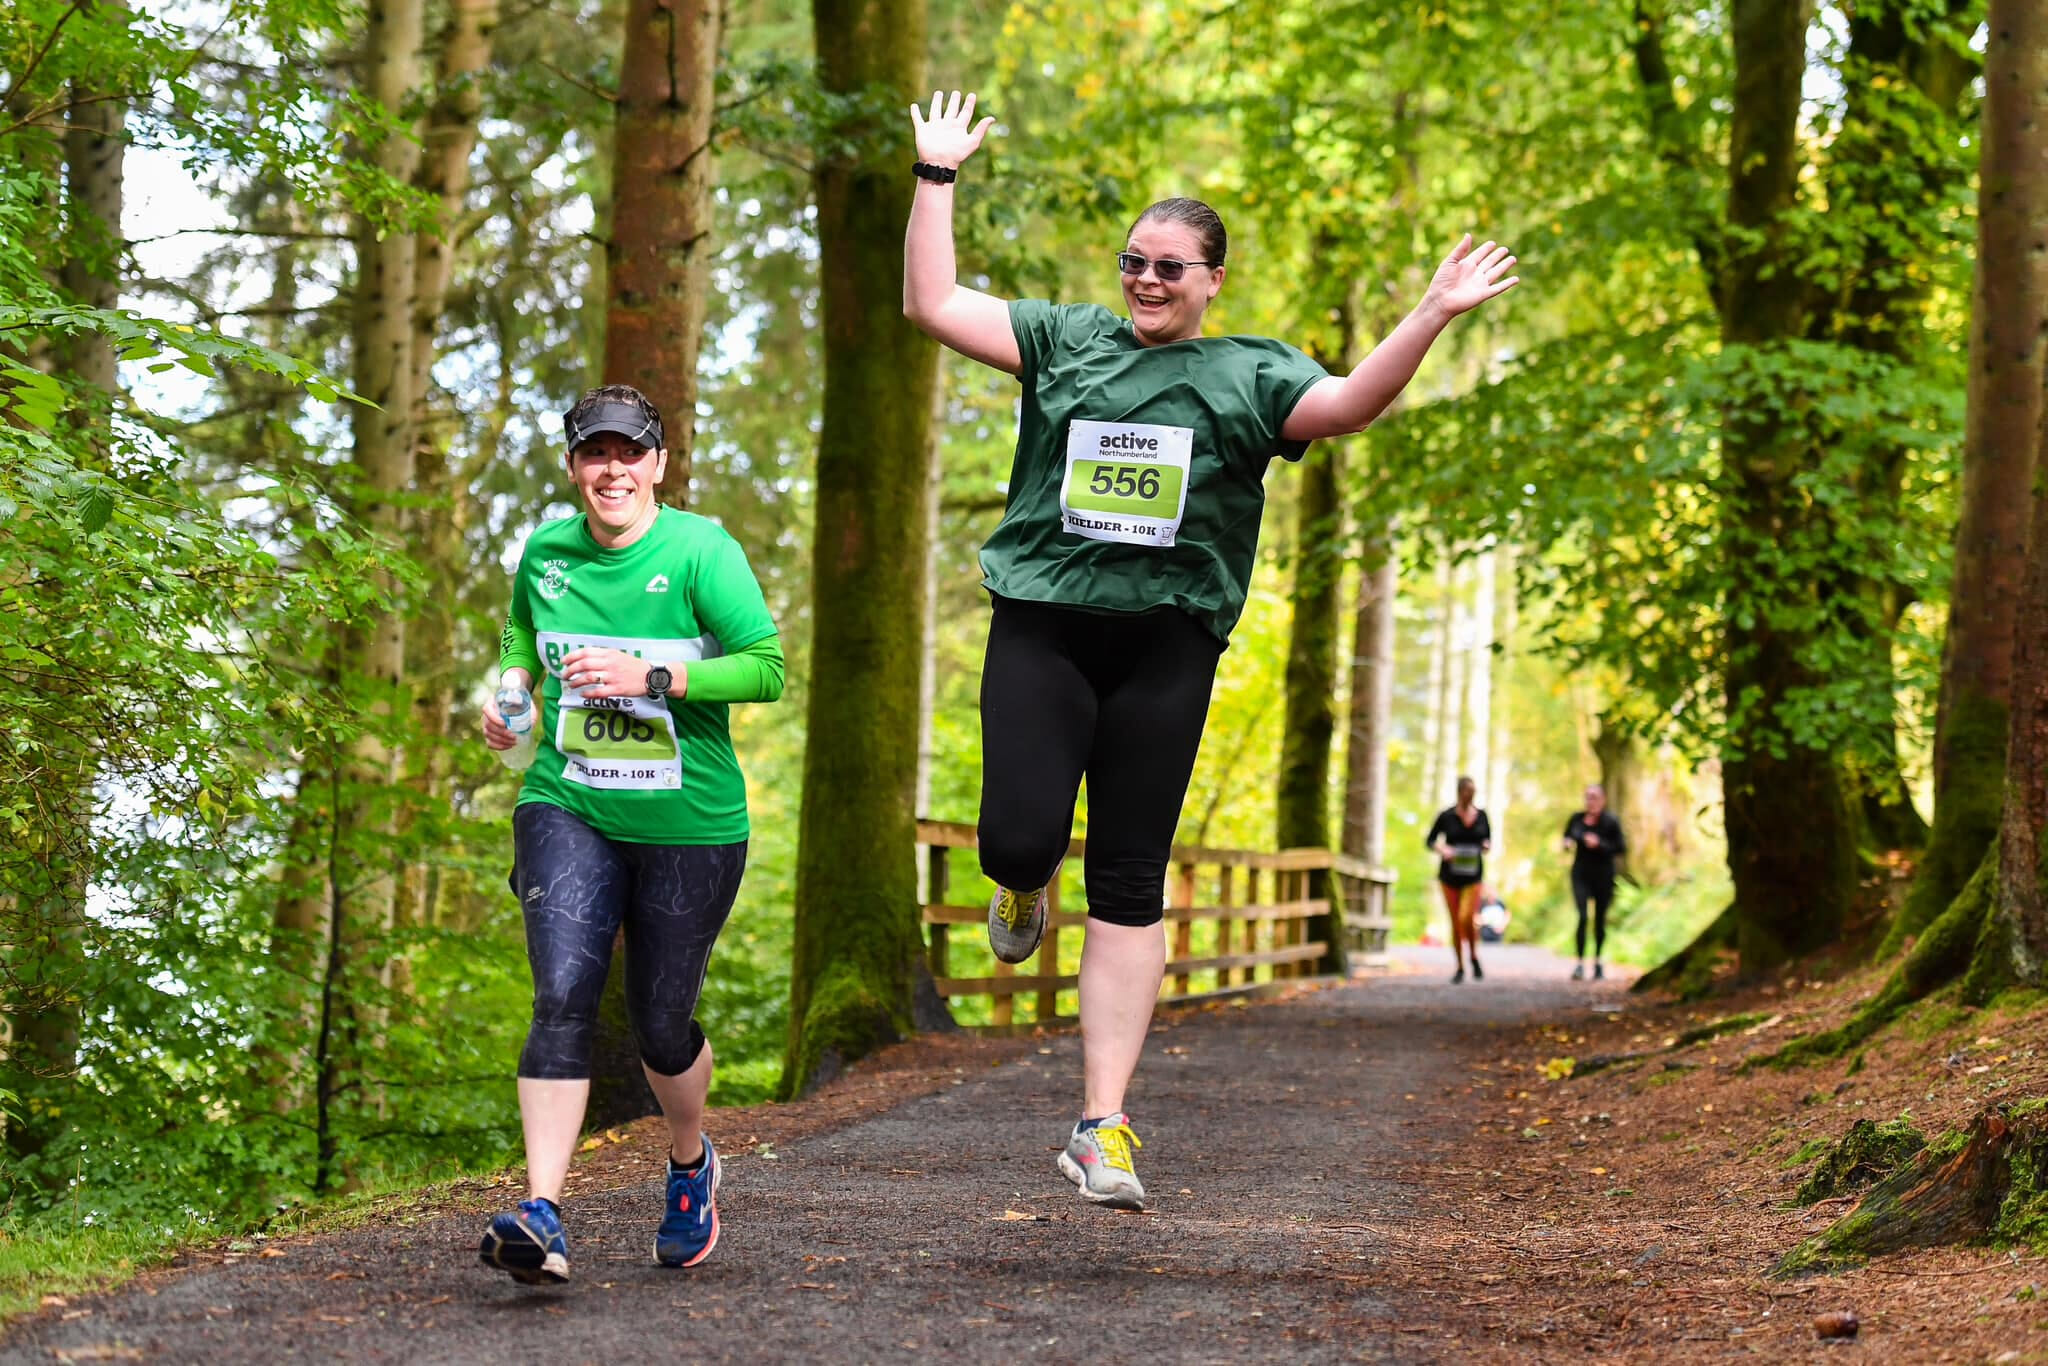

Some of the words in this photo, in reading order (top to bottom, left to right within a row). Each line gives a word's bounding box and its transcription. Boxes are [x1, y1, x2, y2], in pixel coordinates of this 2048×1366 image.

[1100, 432, 1158, 450] active
[1099, 450, 1158, 459] Northumberland
[1090, 465, 1161, 500] 556
[1068, 515, 1122, 533] KIELDER
[1132, 524, 1157, 536] 10K
[583, 711, 655, 743] 605
[630, 769, 656, 779] 10K
